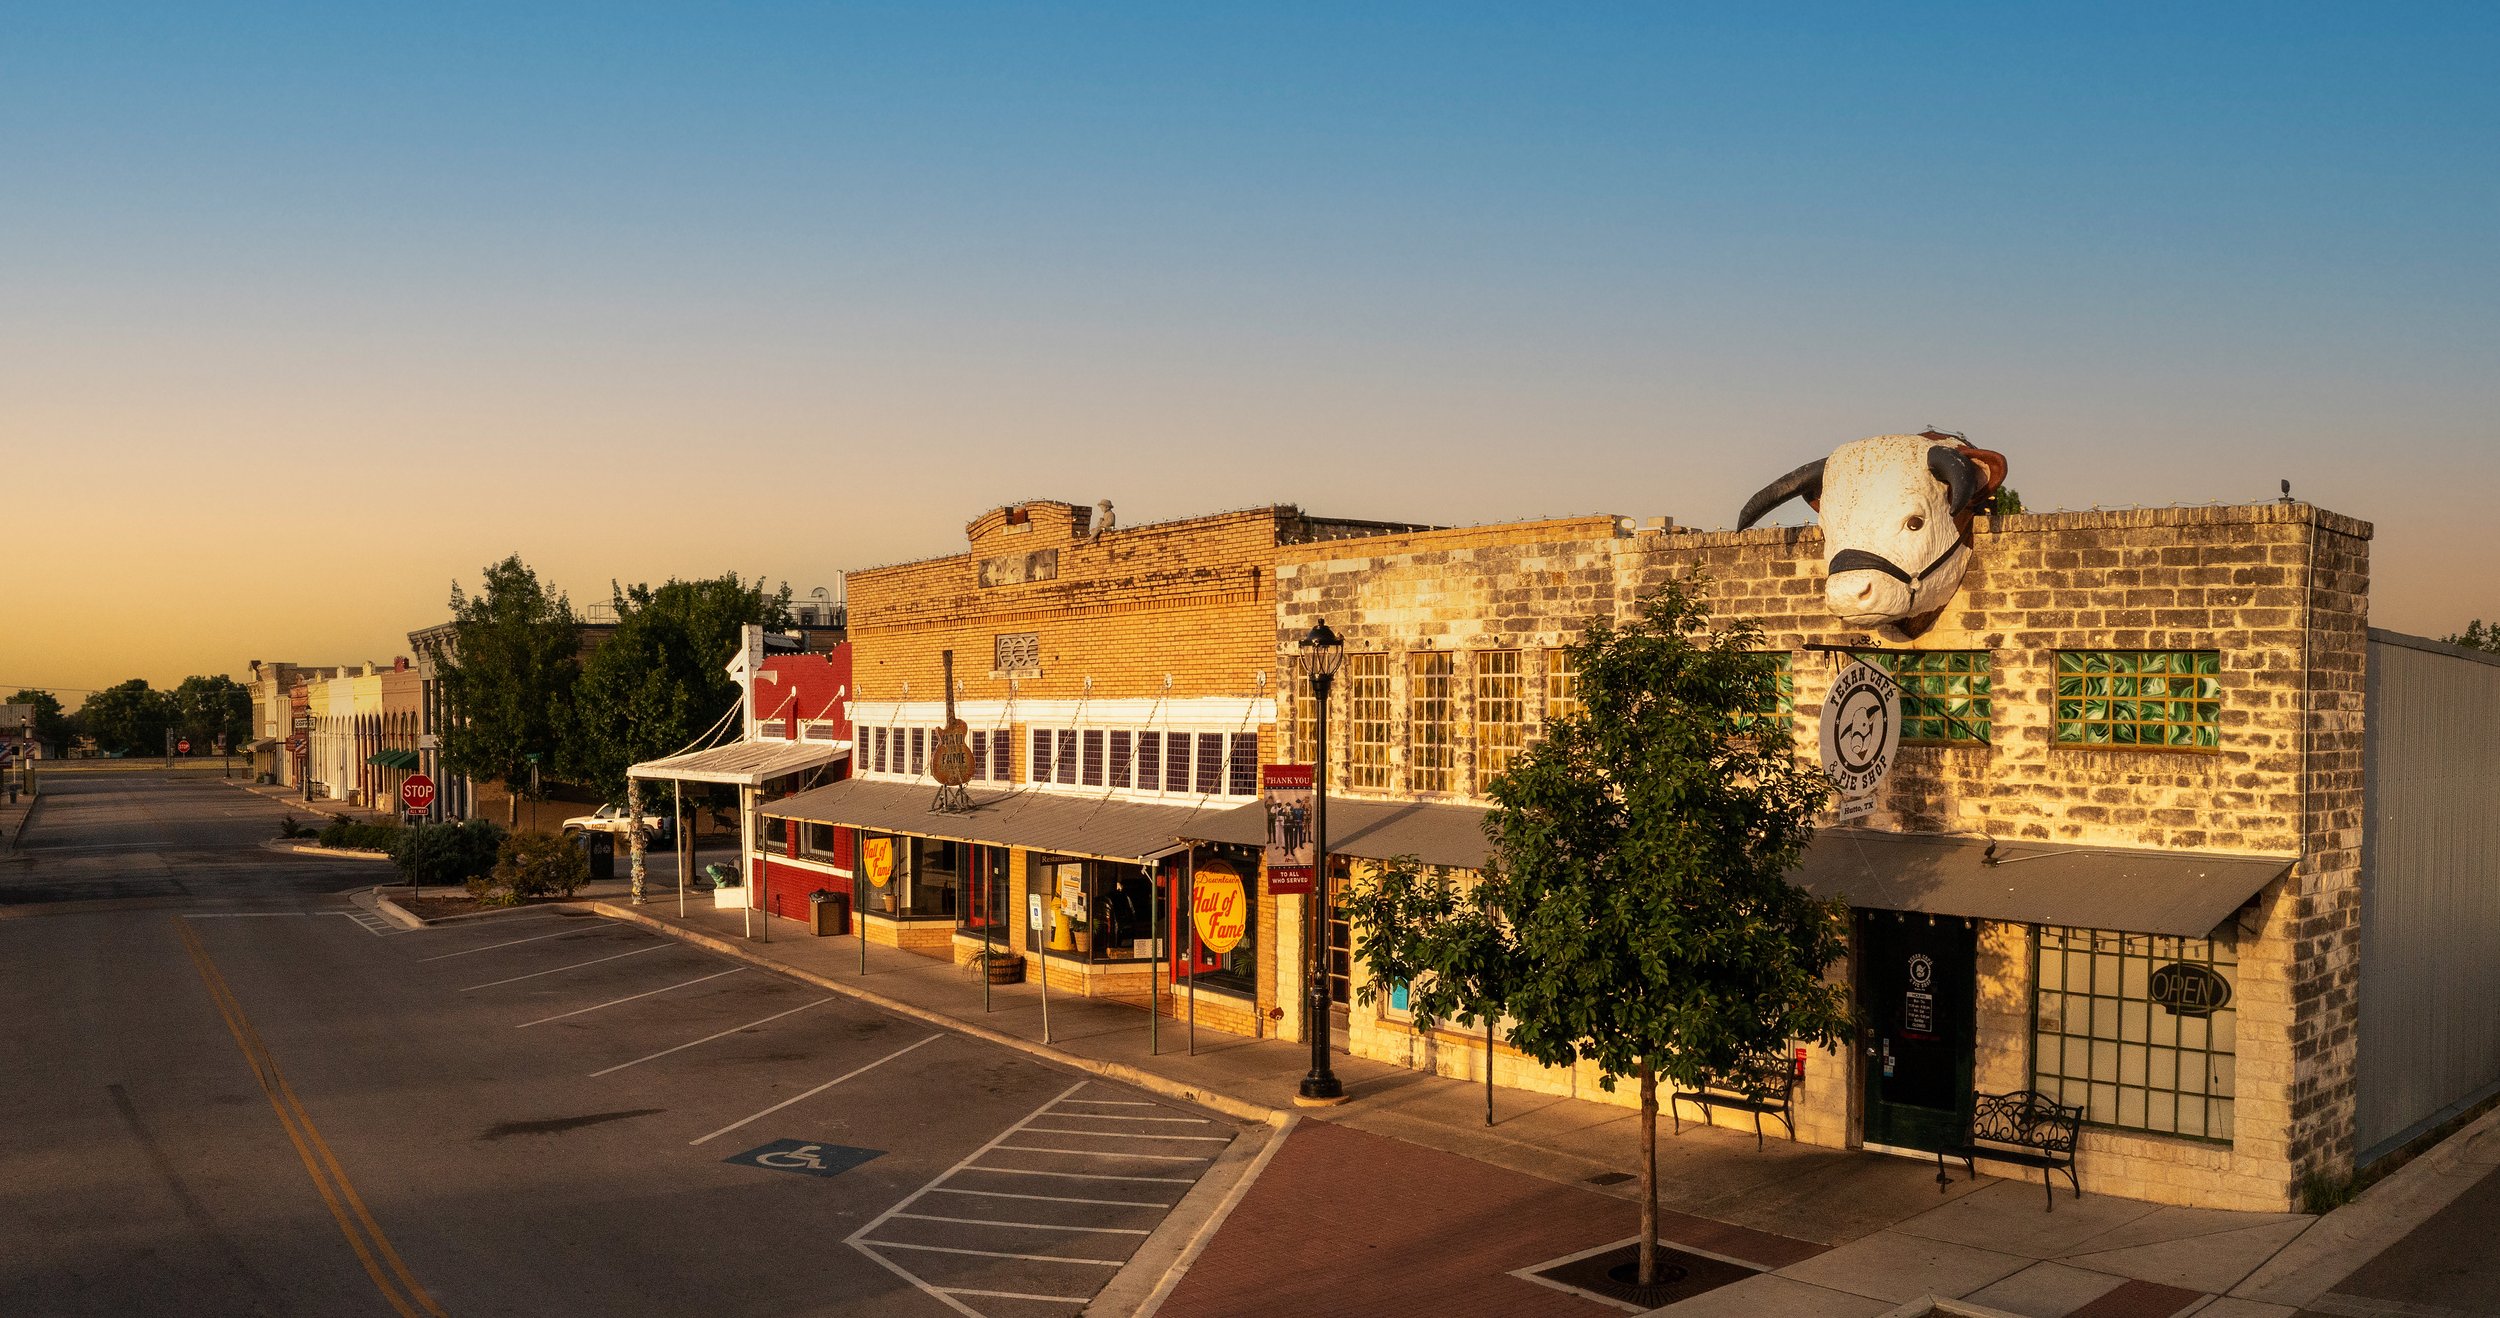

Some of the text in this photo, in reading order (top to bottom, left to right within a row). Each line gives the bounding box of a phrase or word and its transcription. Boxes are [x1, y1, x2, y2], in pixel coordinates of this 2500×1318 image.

[1830, 667, 1866, 707] TEXAN
[942, 734, 964, 745] HALL
[942, 753, 966, 764] FAME
[1265, 776, 1310, 784] THANK YOU
[1838, 770, 1858, 791] PIE
[1862, 755, 1887, 789] SHOP
[404, 785, 434, 798] STOP
[1844, 801, 1874, 815] Hutto, TX
[864, 839, 888, 861] Hall of
[872, 857, 891, 877] Fame
[1195, 873, 1240, 885] Downtown
[1193, 886, 1237, 917] Hall of
[1209, 911, 1244, 939] Fame
[2152, 972, 2214, 1005] OPEN
